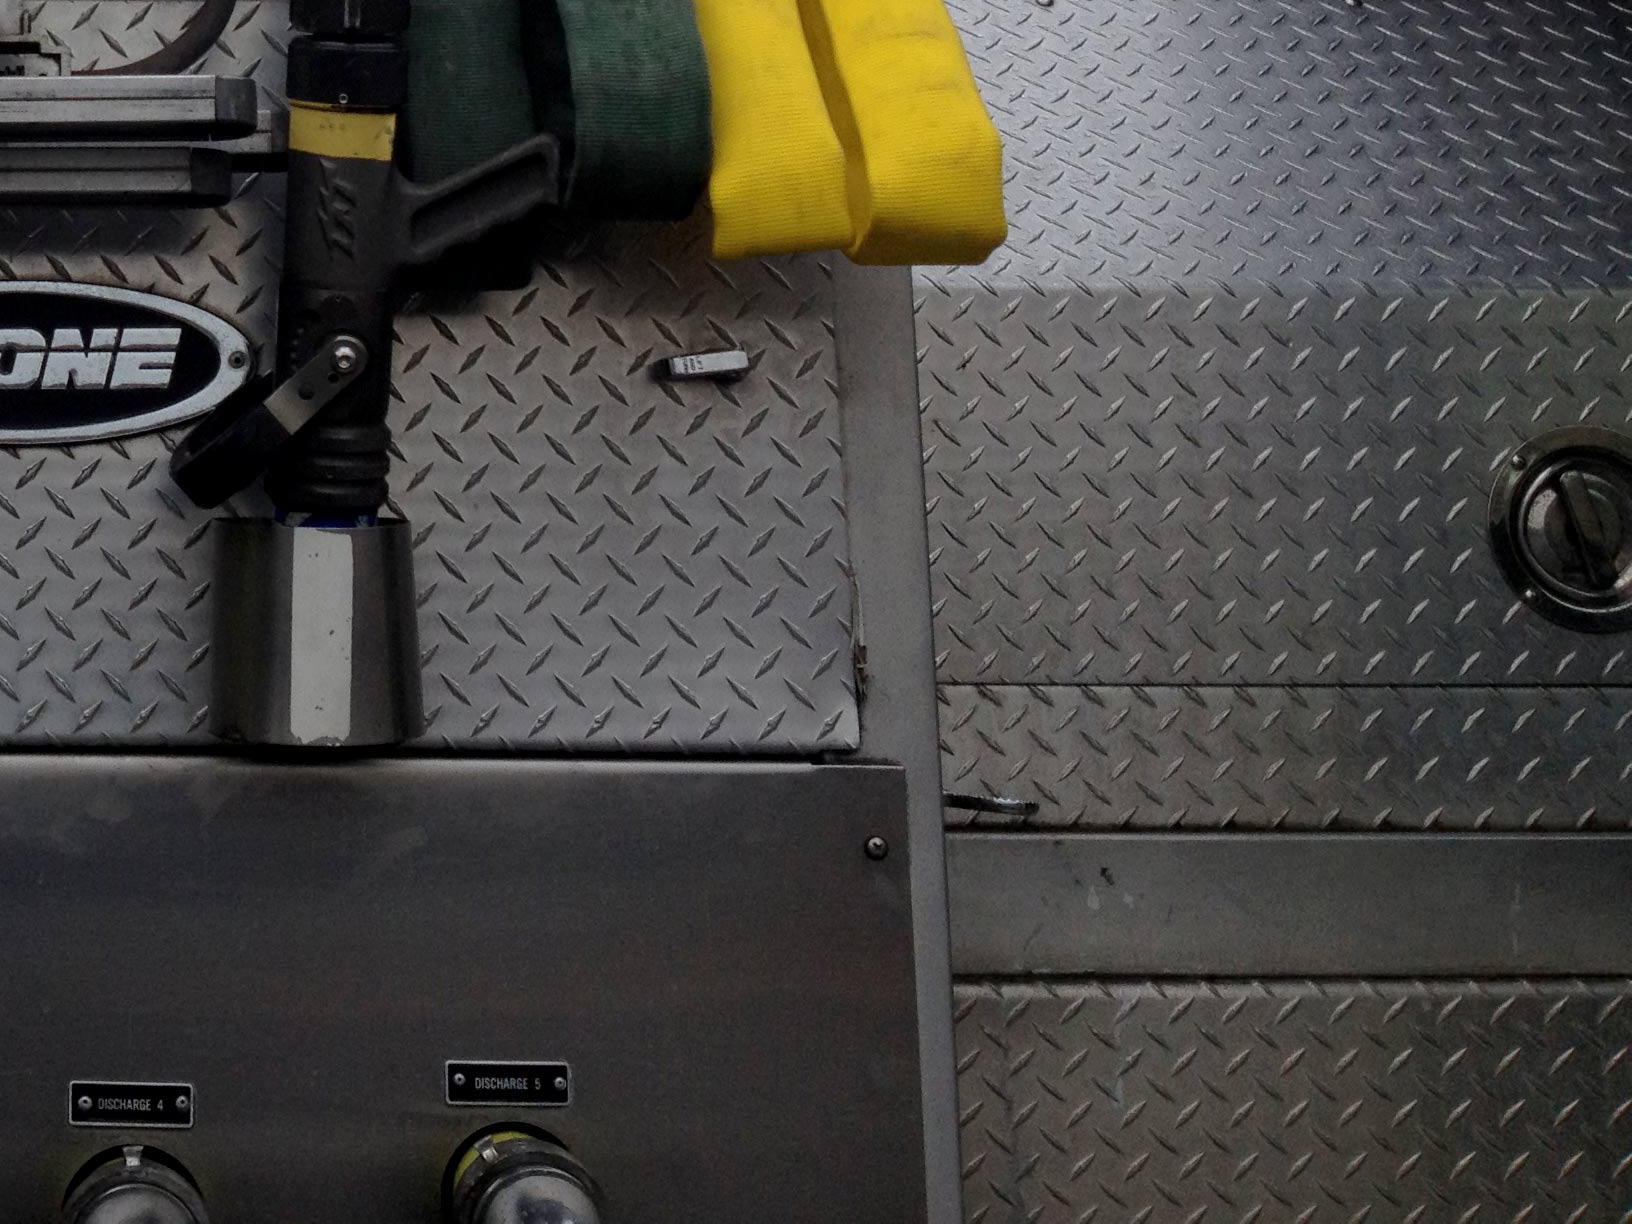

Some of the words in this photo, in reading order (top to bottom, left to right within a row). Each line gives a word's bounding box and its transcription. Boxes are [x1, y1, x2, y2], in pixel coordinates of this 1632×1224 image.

[474, 1077, 528, 1090] DISCHARGE
[534, 1078, 541, 1091] 5
[98, 1097, 151, 1111] DISCHARGE
[157, 1099, 164, 1112] 4
